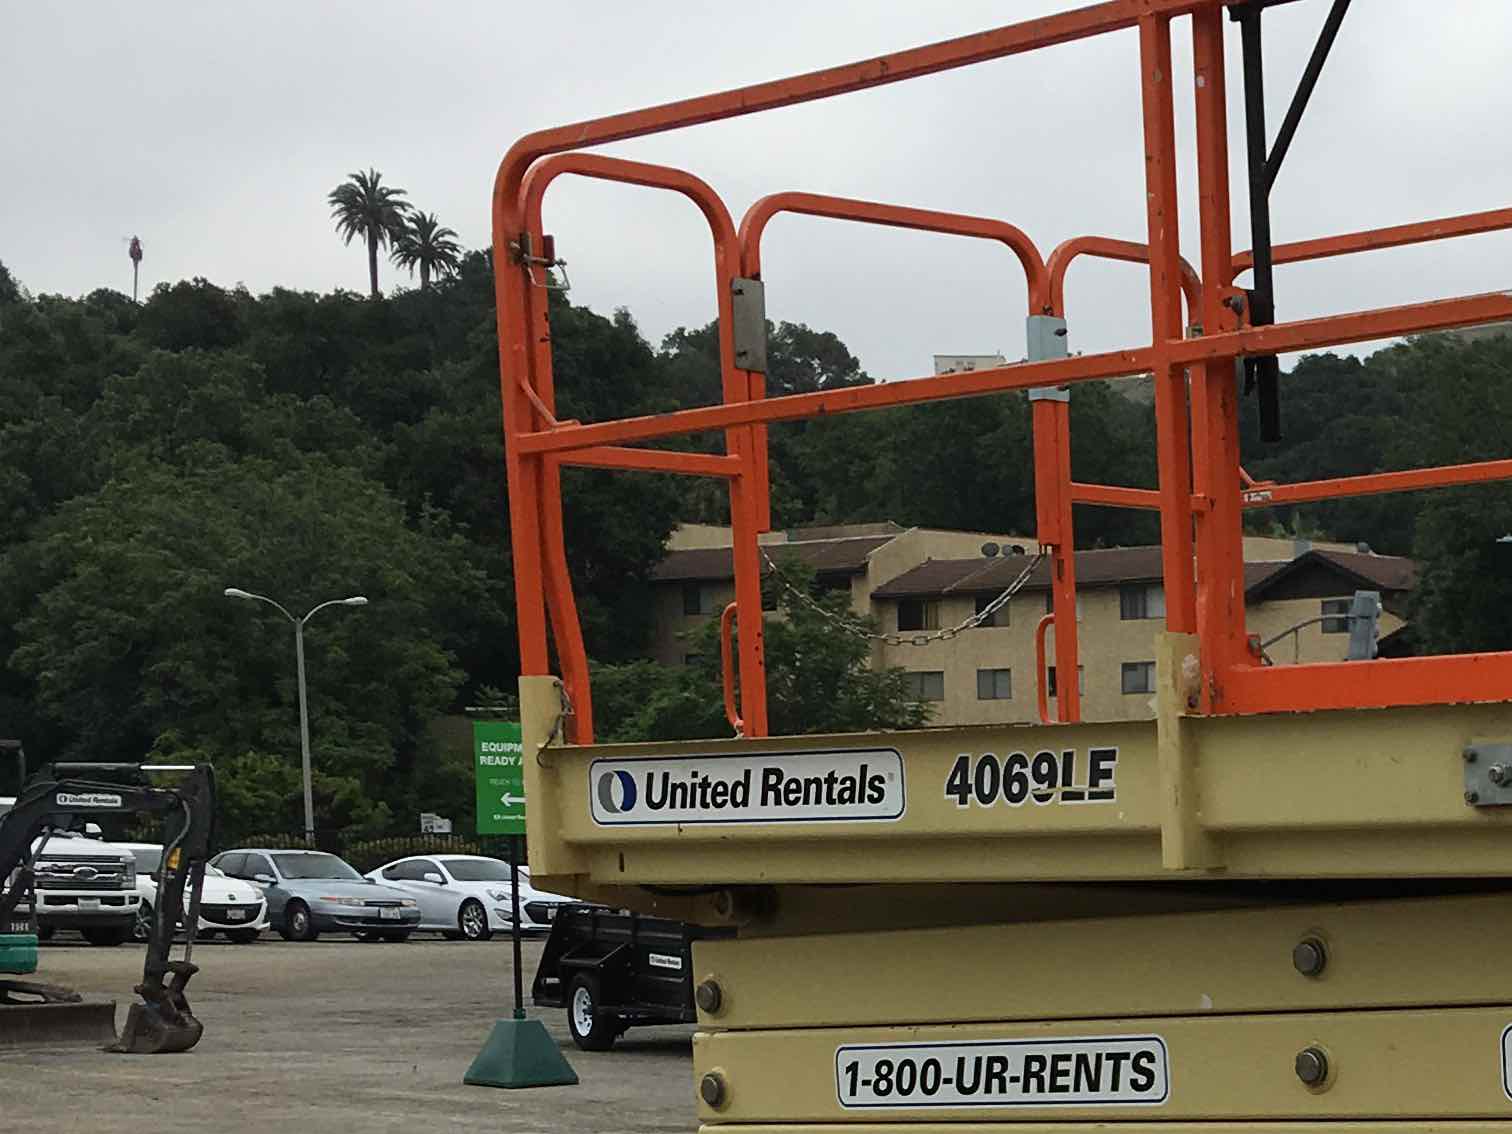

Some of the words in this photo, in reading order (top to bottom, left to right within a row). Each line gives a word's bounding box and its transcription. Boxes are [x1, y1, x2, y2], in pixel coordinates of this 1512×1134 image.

[480, 756, 515, 766] READY
[481, 742, 523, 752] EQUIPM
[646, 769, 750, 810] United
[761, 765, 885, 807] Rentals
[944, 748, 1118, 808] 4069LE
[844, 1050, 1156, 1097] 1-800-UR-RENTS
